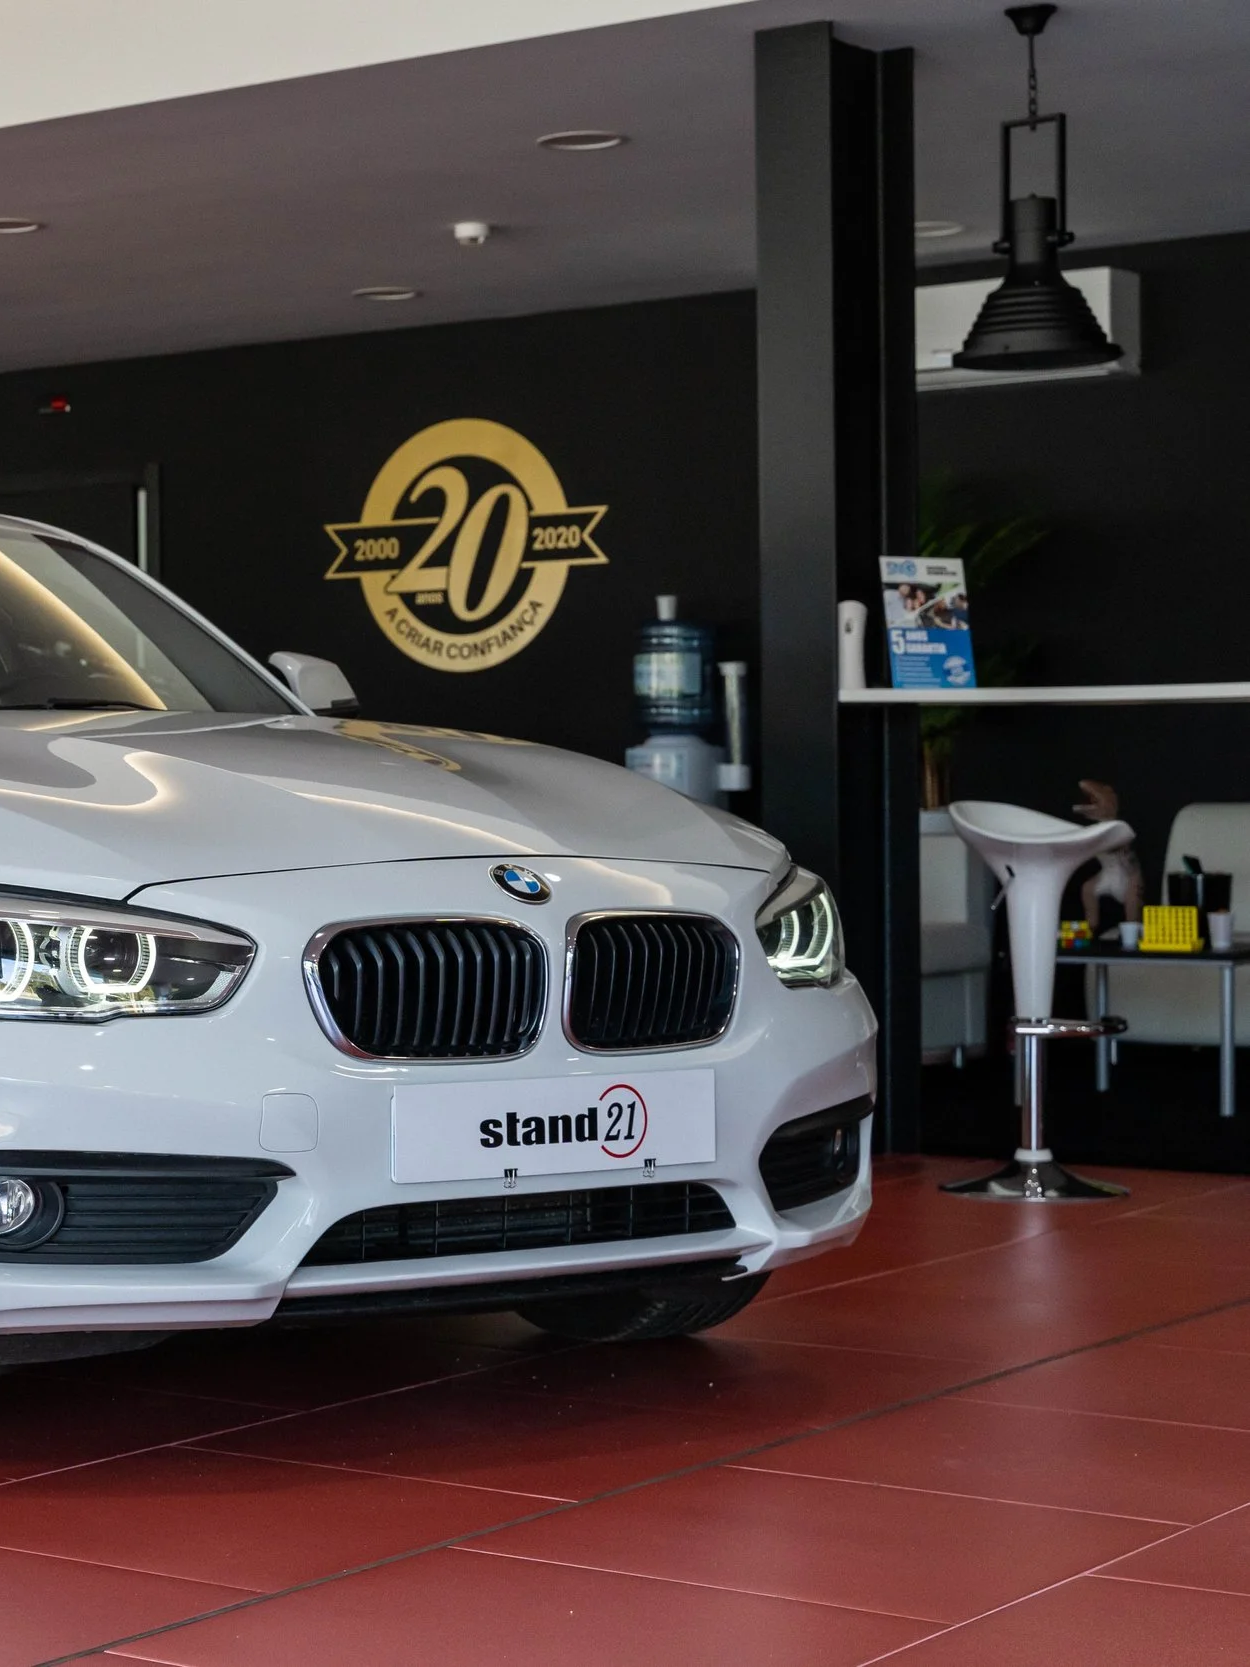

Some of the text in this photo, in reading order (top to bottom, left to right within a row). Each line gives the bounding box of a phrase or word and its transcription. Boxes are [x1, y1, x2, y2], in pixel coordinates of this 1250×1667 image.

[353, 537, 400, 561] 2000
[387, 466, 529, 621] 20
[532, 525, 581, 550] 2020
[385, 599, 543, 659] A CRIAR CONFIANÇA
[891, 630, 905, 655] 5
[479, 1101, 637, 1149] stand 21
